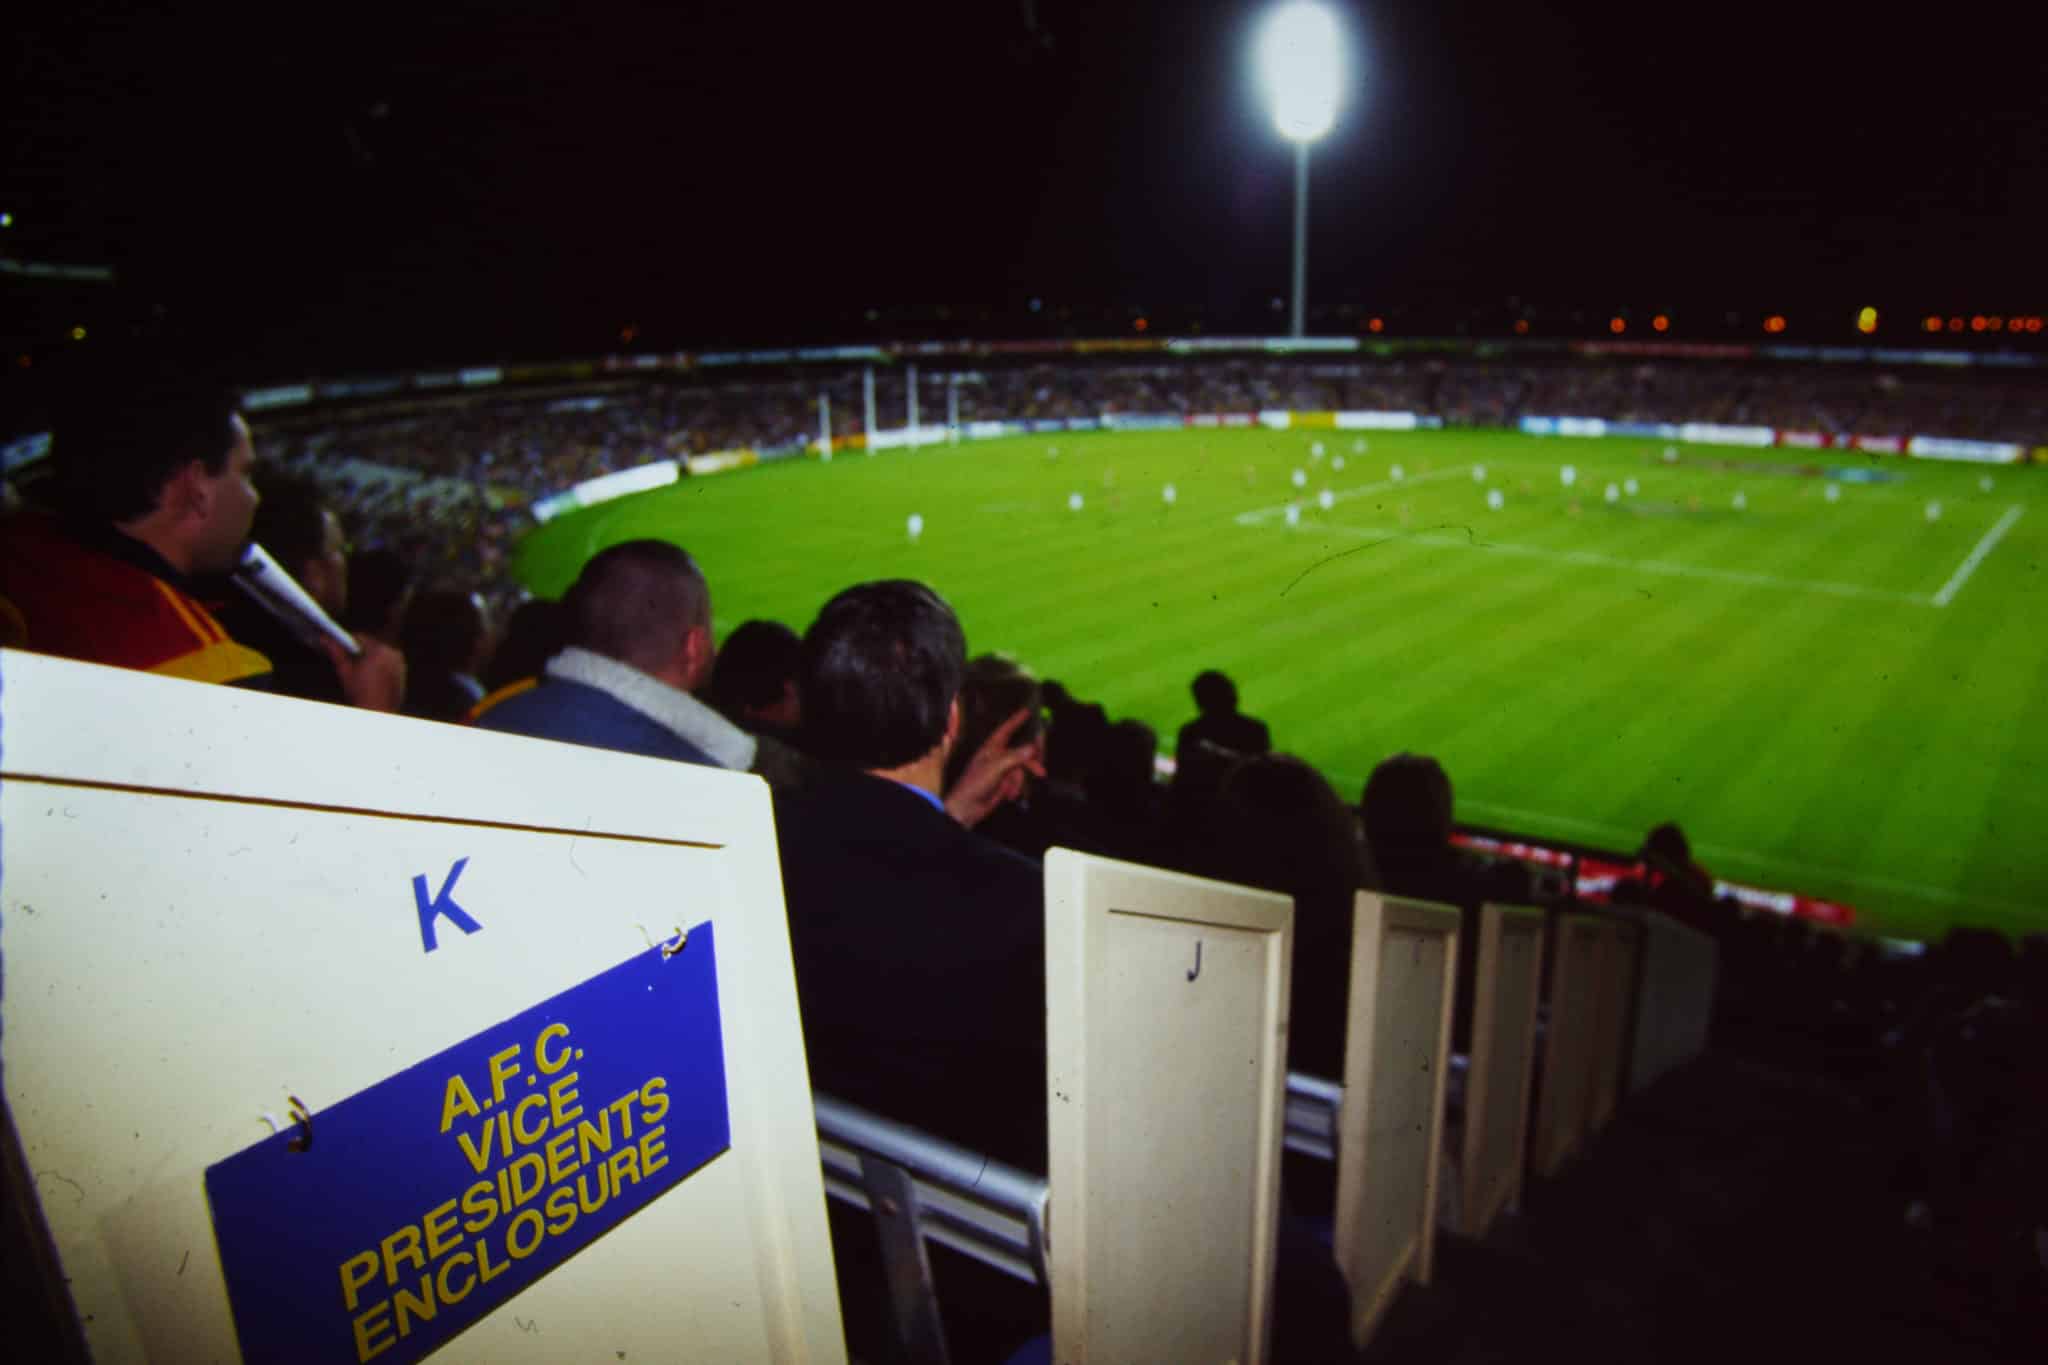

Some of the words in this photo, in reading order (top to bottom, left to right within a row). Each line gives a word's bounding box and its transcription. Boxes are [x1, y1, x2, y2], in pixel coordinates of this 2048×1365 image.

[412, 857, 482, 953] K
[1186, 941, 1202, 983] J
[440, 1023, 583, 1132] A.F.C.
[457, 1072, 583, 1174] VICE
[338, 1077, 670, 1311] PRESIDENTS
[351, 1126, 669, 1363] ENCLOSURE
